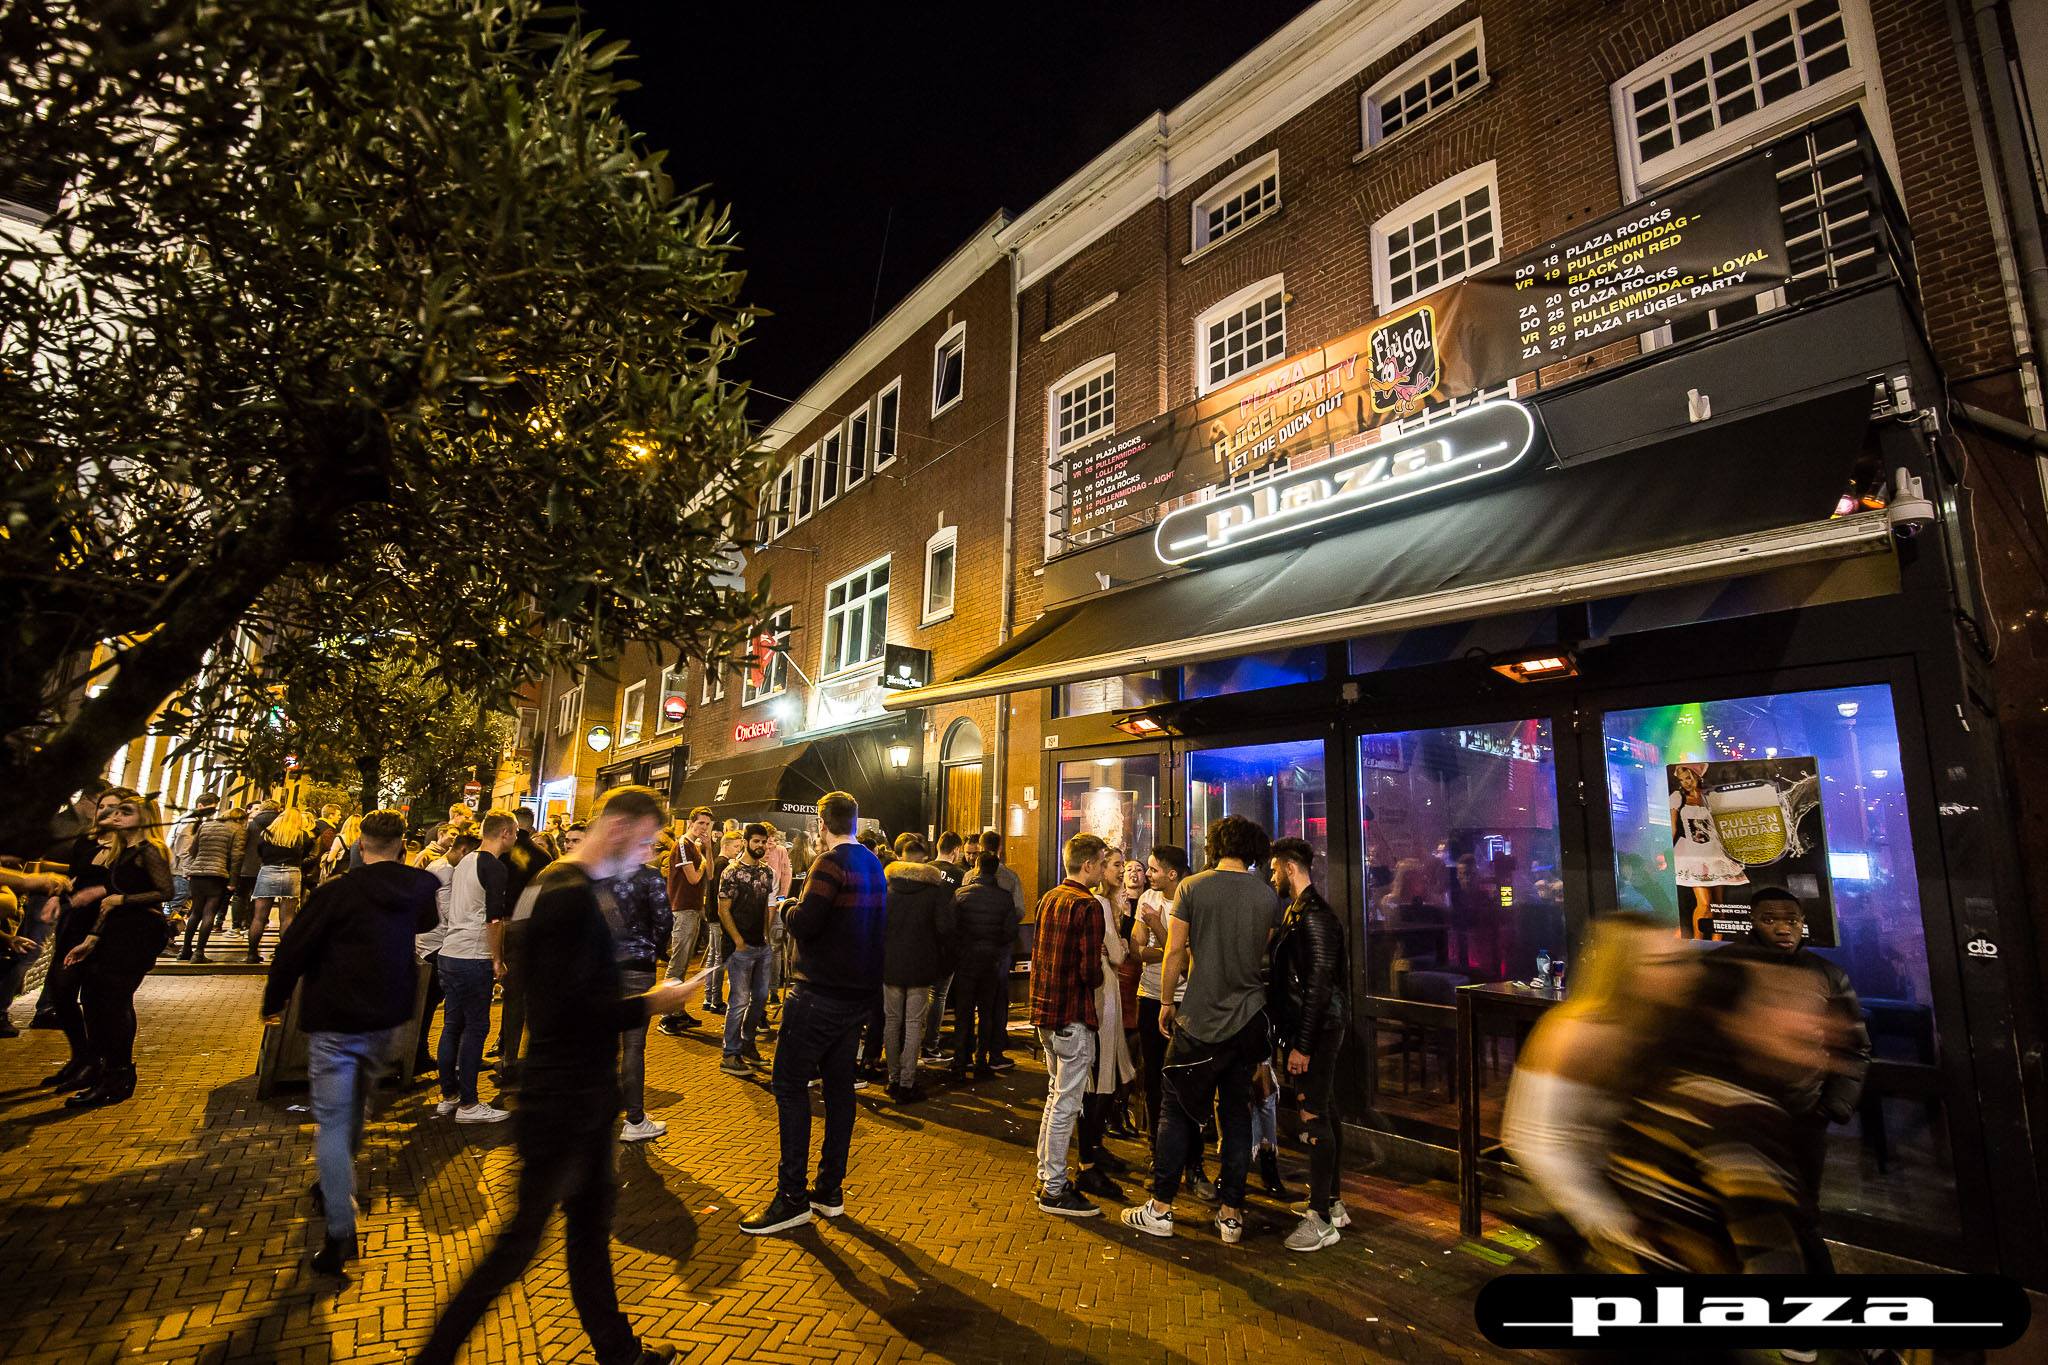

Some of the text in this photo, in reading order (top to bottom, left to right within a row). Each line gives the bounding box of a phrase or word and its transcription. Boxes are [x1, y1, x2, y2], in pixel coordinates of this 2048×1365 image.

[1515, 208, 1672, 280] DO 18 PLAZA ROCKS
[1515, 278, 1534, 292] VR
[1544, 268, 1561, 281] 19
[1567, 217, 1688, 273] PULLENMIDDAG
[1568, 234, 1682, 285] BLACK ON RED
[1519, 265, 1645, 319] ZA 20 GO PLAZA
[1520, 266, 1679, 332] DO 25 PLAZA ROCKS
[1521, 332, 1540, 345] VR
[1548, 322, 1566, 337] 26
[1573, 274, 1694, 327] PULLENMIDDAG
[1712, 249, 1769, 277] LOYAL
[1522, 271, 1748, 359] ZA 27 PLAZA FLÜGEL PARTY
[1372, 309, 1430, 373] Flügel
[1240, 362, 1308, 419] PLAZA
[1288, 353, 1359, 414] PARTY
[1073, 436, 1141, 470] DO 04 PLAZA ROCKS
[1228, 391, 1344, 475] LET THE DUCK OUT
[1072, 471, 1081, 479] VR
[1096, 444, 1146, 470] PULLENMIDDAG
[1096, 460, 1128, 479] LOLLI POP
[1096, 480, 1105, 488] GO
[1106, 470, 1127, 484] PLAZA
[1072, 507, 1081, 515] VR
[1096, 482, 1146, 507] PULLENMIDDAG
[1154, 470, 1175, 484] AIGHT
[1073, 498, 1082, 506] DO
[1096, 484, 1116, 498] PLAZA
[1117, 474, 1140, 489] ROCKS
[1085, 512, 1092, 520] 13
[1095, 508, 1104, 516] GO
[1106, 499, 1128, 512] PLAZA
[1206, 439, 1451, 548] plaza
[1722, 782, 1756, 790] plaza
[1720, 813, 1777, 829] PULLEN
[1722, 823, 1780, 839] MIDDAG
